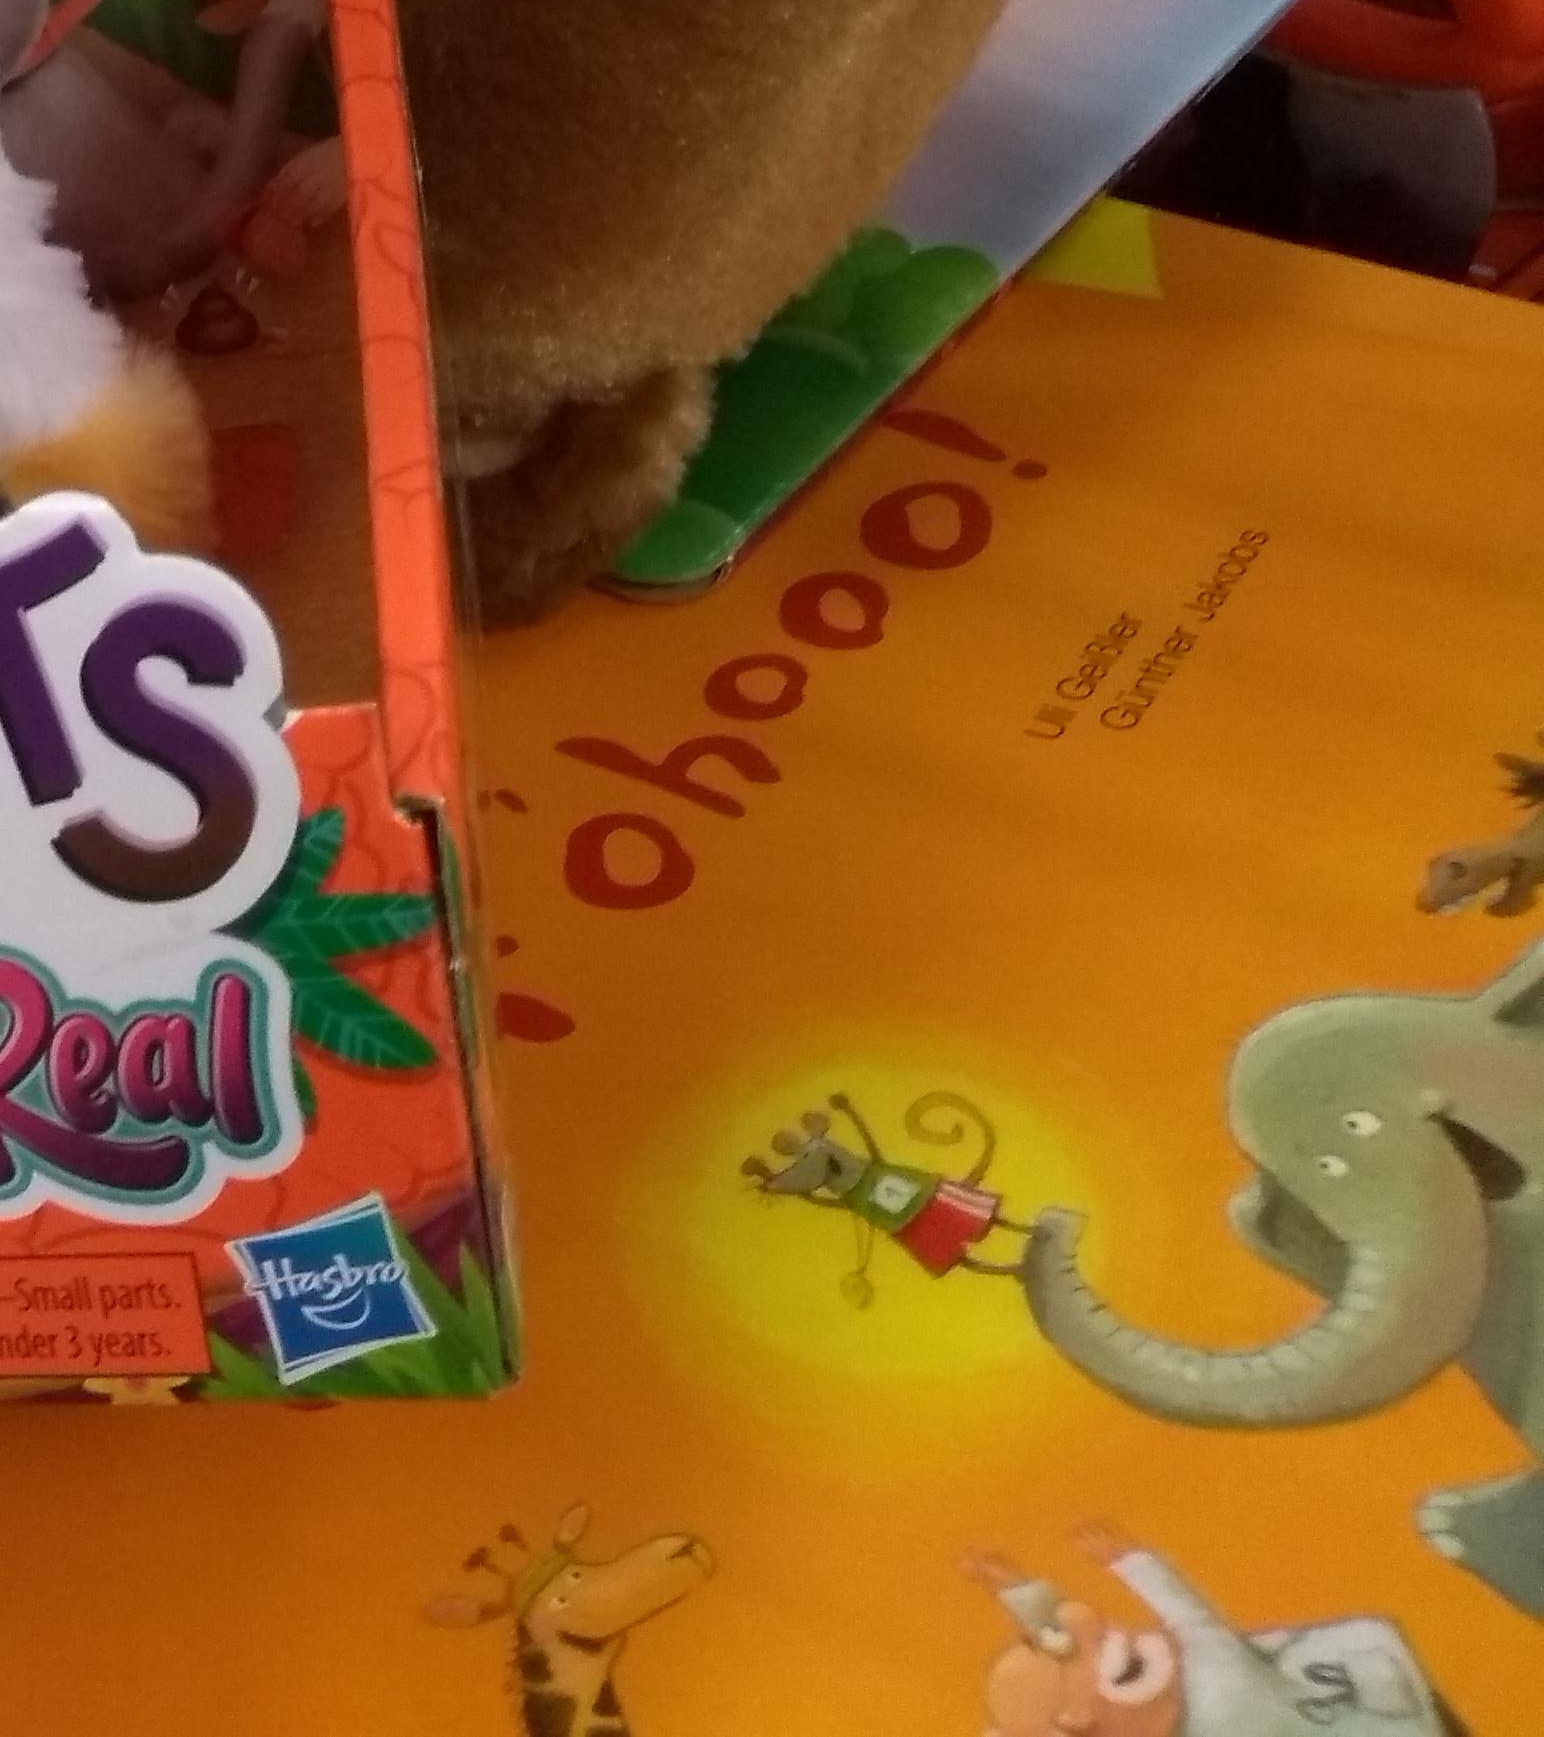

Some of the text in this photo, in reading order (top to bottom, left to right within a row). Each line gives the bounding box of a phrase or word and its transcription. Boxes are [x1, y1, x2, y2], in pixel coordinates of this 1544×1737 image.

[1099, 529, 1270, 731] Günther Jakobs
[98, 1278, 182, 1320] parts.
[246, 1252, 410, 1301] Hasbro
[65, 1324, 83, 1359] 3
[86, 1328, 174, 1368] years.
